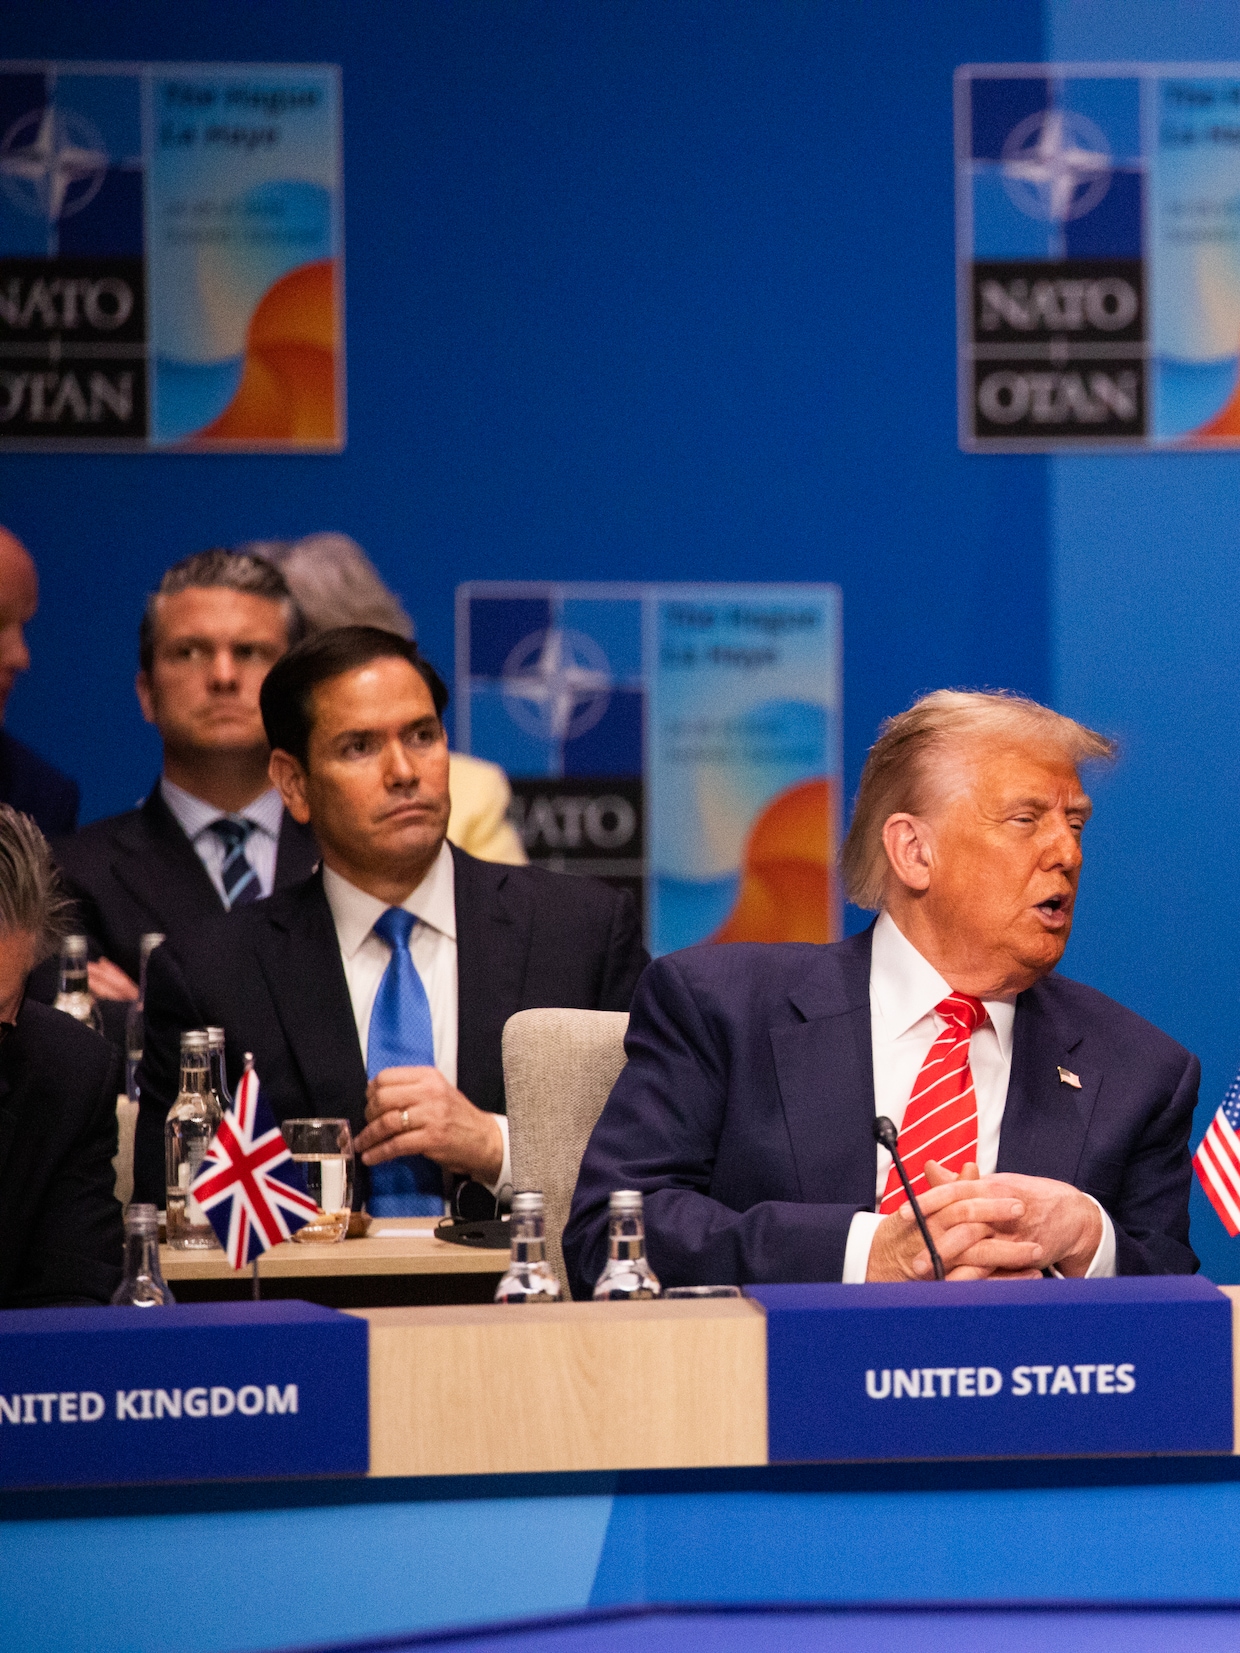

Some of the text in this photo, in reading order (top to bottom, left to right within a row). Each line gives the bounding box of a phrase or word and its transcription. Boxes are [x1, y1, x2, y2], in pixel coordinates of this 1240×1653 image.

[981, 279, 1138, 330] NATO
[978, 372, 1137, 422] OTAN
[0, 1383, 299, 1425] NITED KINGDOM
[865, 1363, 1136, 1400] UNITED STATES
